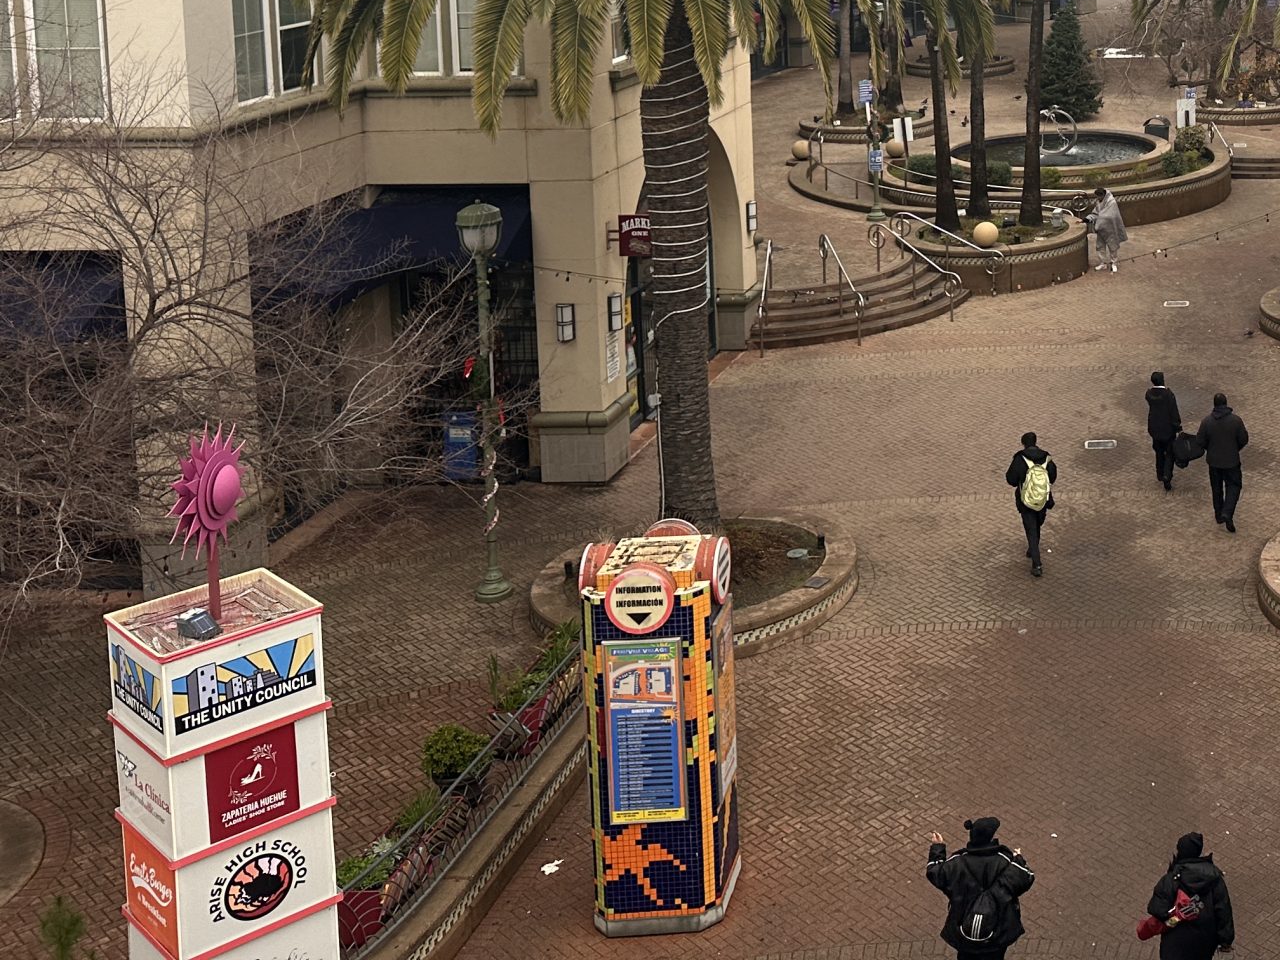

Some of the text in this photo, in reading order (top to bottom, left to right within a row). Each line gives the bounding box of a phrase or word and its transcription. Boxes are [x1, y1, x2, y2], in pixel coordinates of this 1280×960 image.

[616, 585, 662, 594] INFORMATION
[616, 598, 663, 608] INFORMACIÓN
[181, 674, 312, 729] THE UNITY COUNCIL
[134, 774, 143, 792] La
[221, 801, 259, 823] ZAPATERIA
[149, 868, 172, 900] Burger
[209, 840, 307, 922] ARISE HIGH SCHOOL
